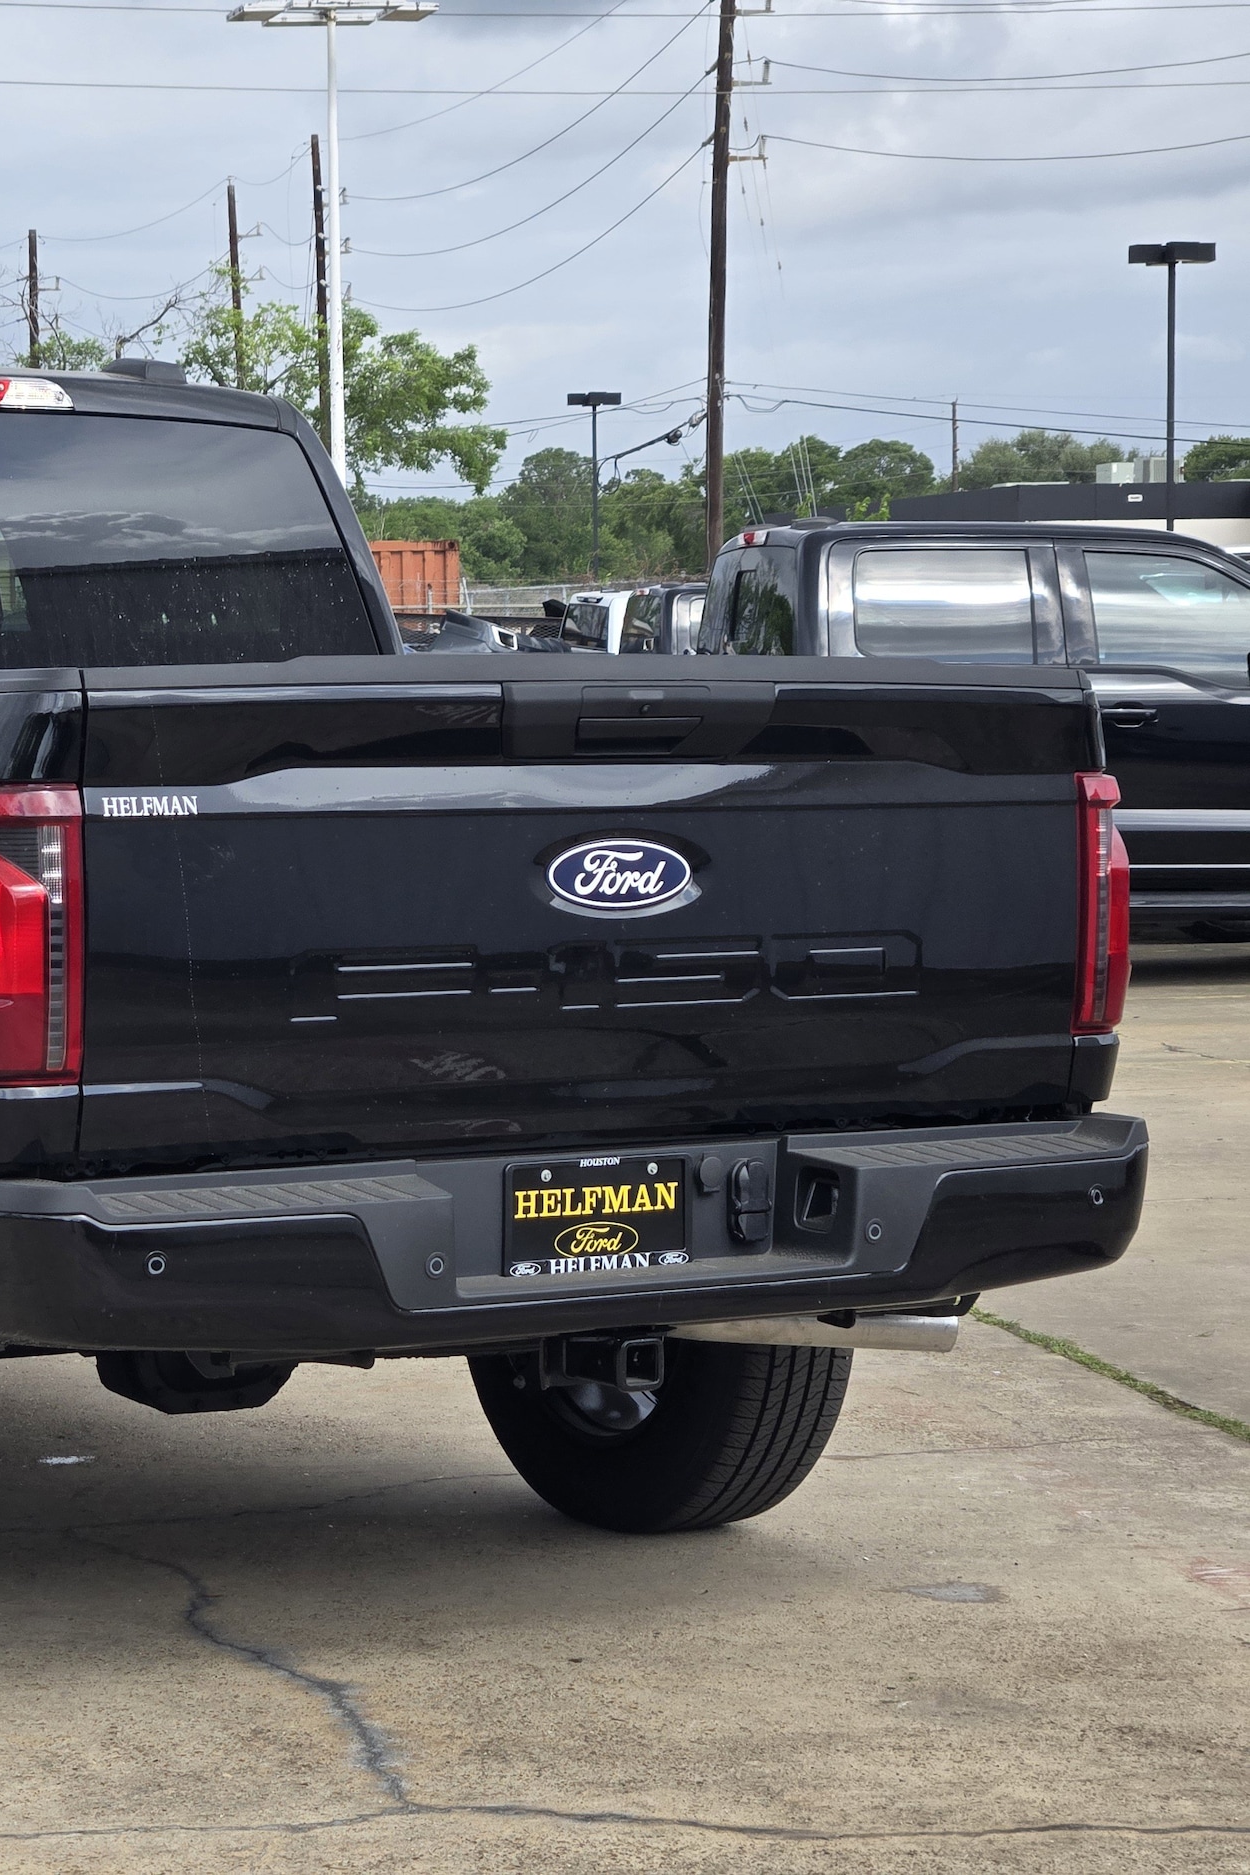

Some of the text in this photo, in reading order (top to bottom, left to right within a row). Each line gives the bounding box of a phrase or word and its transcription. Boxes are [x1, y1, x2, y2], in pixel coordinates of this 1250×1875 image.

[102, 795, 198, 817] HELFMAN
[574, 849, 666, 895] Ford
[579, 1156, 621, 1168] HOUSTON
[513, 1181, 679, 1220] HELFMAN
[570, 1226, 623, 1254] Ford
